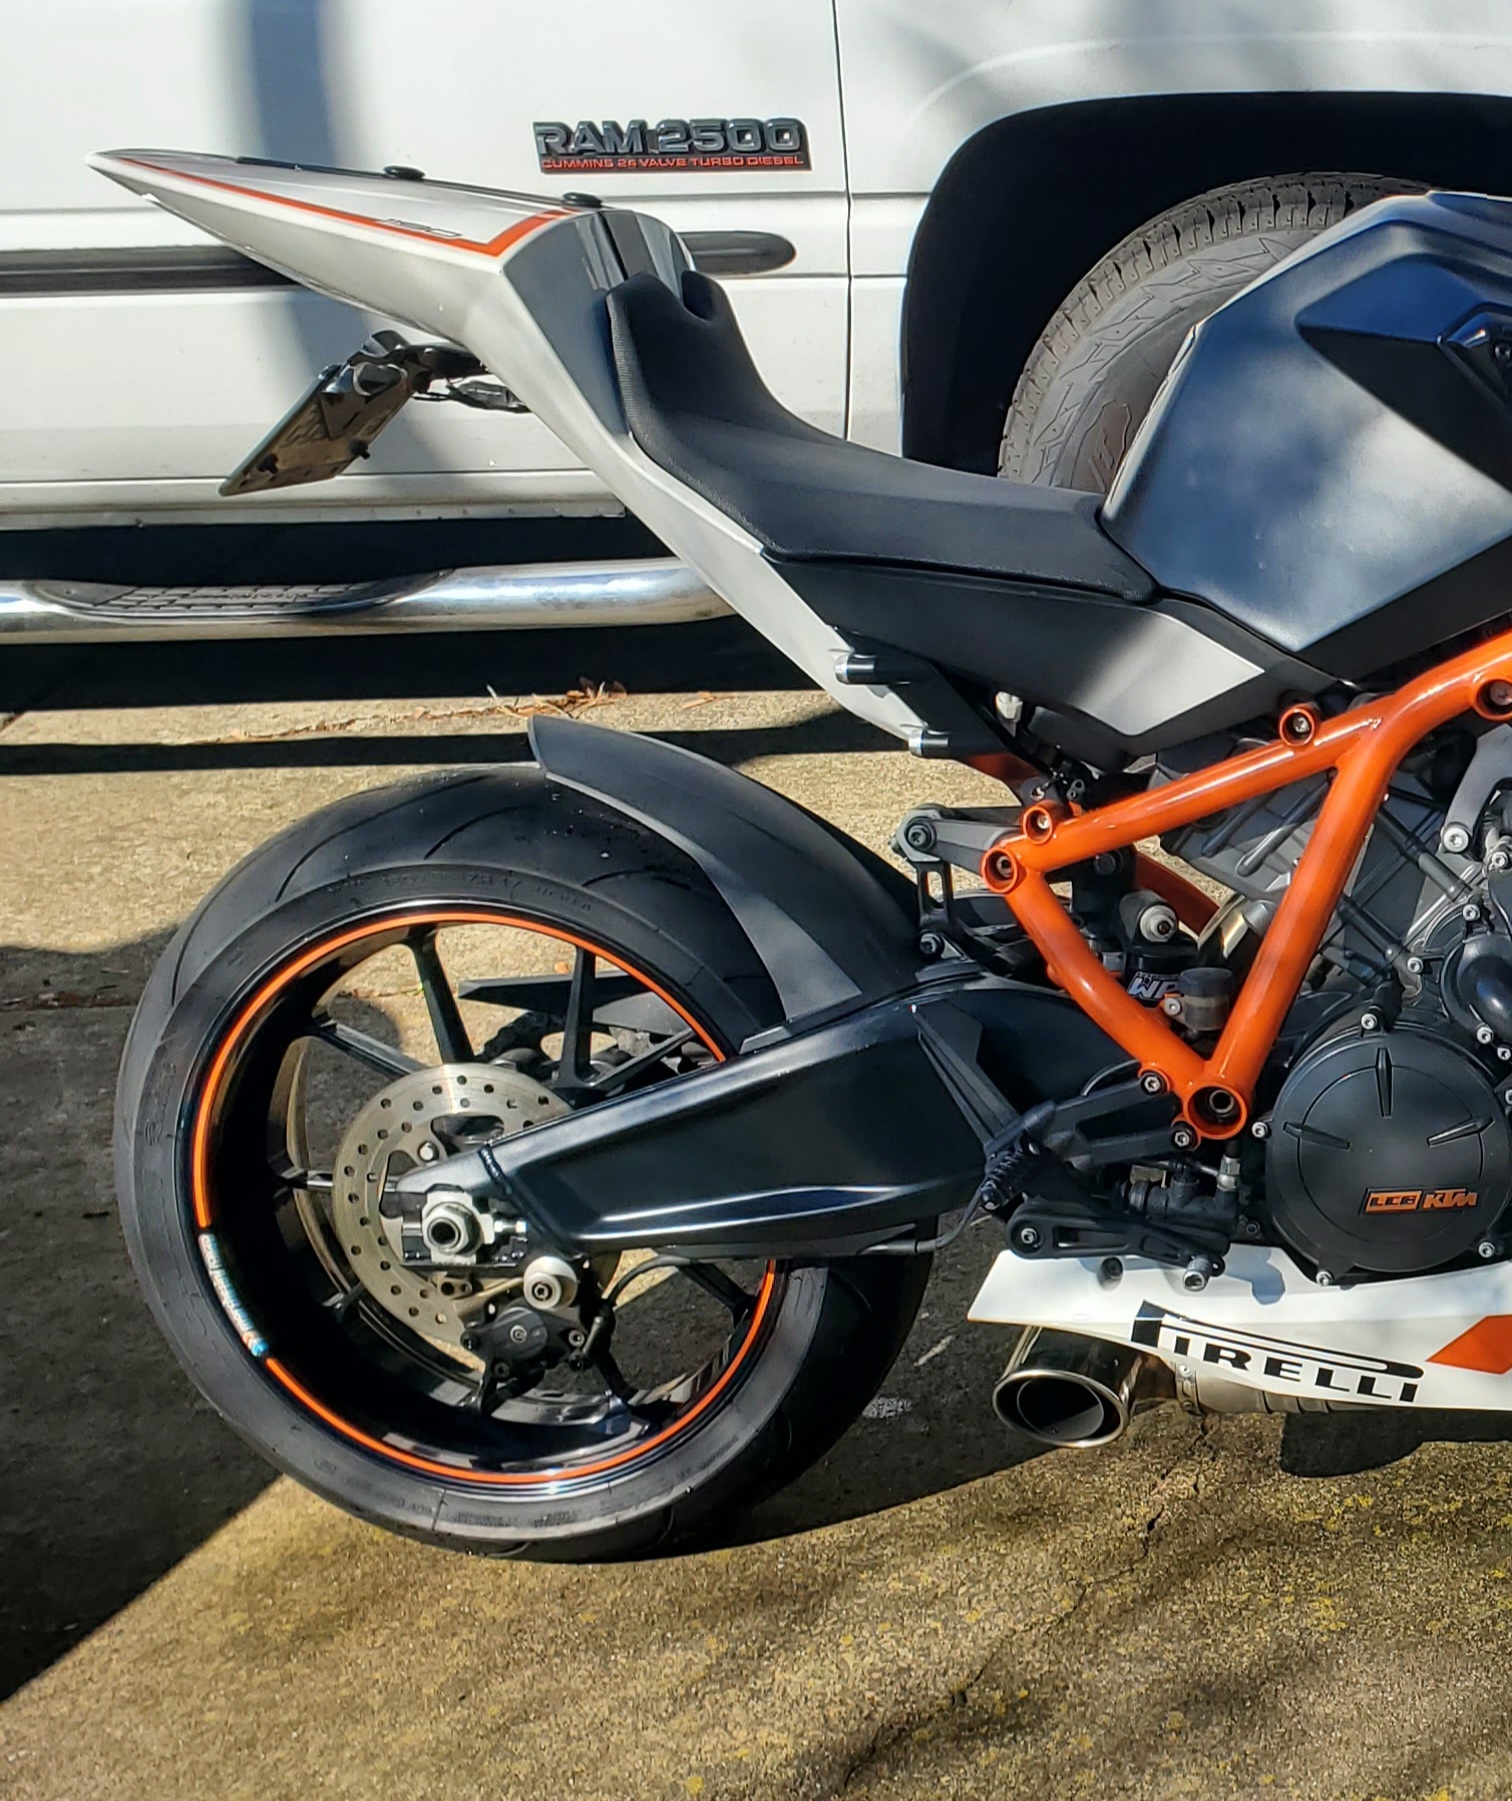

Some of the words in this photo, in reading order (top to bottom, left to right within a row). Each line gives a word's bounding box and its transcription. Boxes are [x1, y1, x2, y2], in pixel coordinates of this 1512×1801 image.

[533, 119, 648, 155] RAM
[654, 117, 807, 152] 2500
[542, 157, 613, 168] CUMMINS
[640, 157, 687, 167] VALVE
[691, 156, 744, 167] TURBO
[746, 156, 805, 166] DIESEL
[1422, 1188, 1478, 1209] KTM
[1131, 1300, 1425, 1403] PIRELLI
